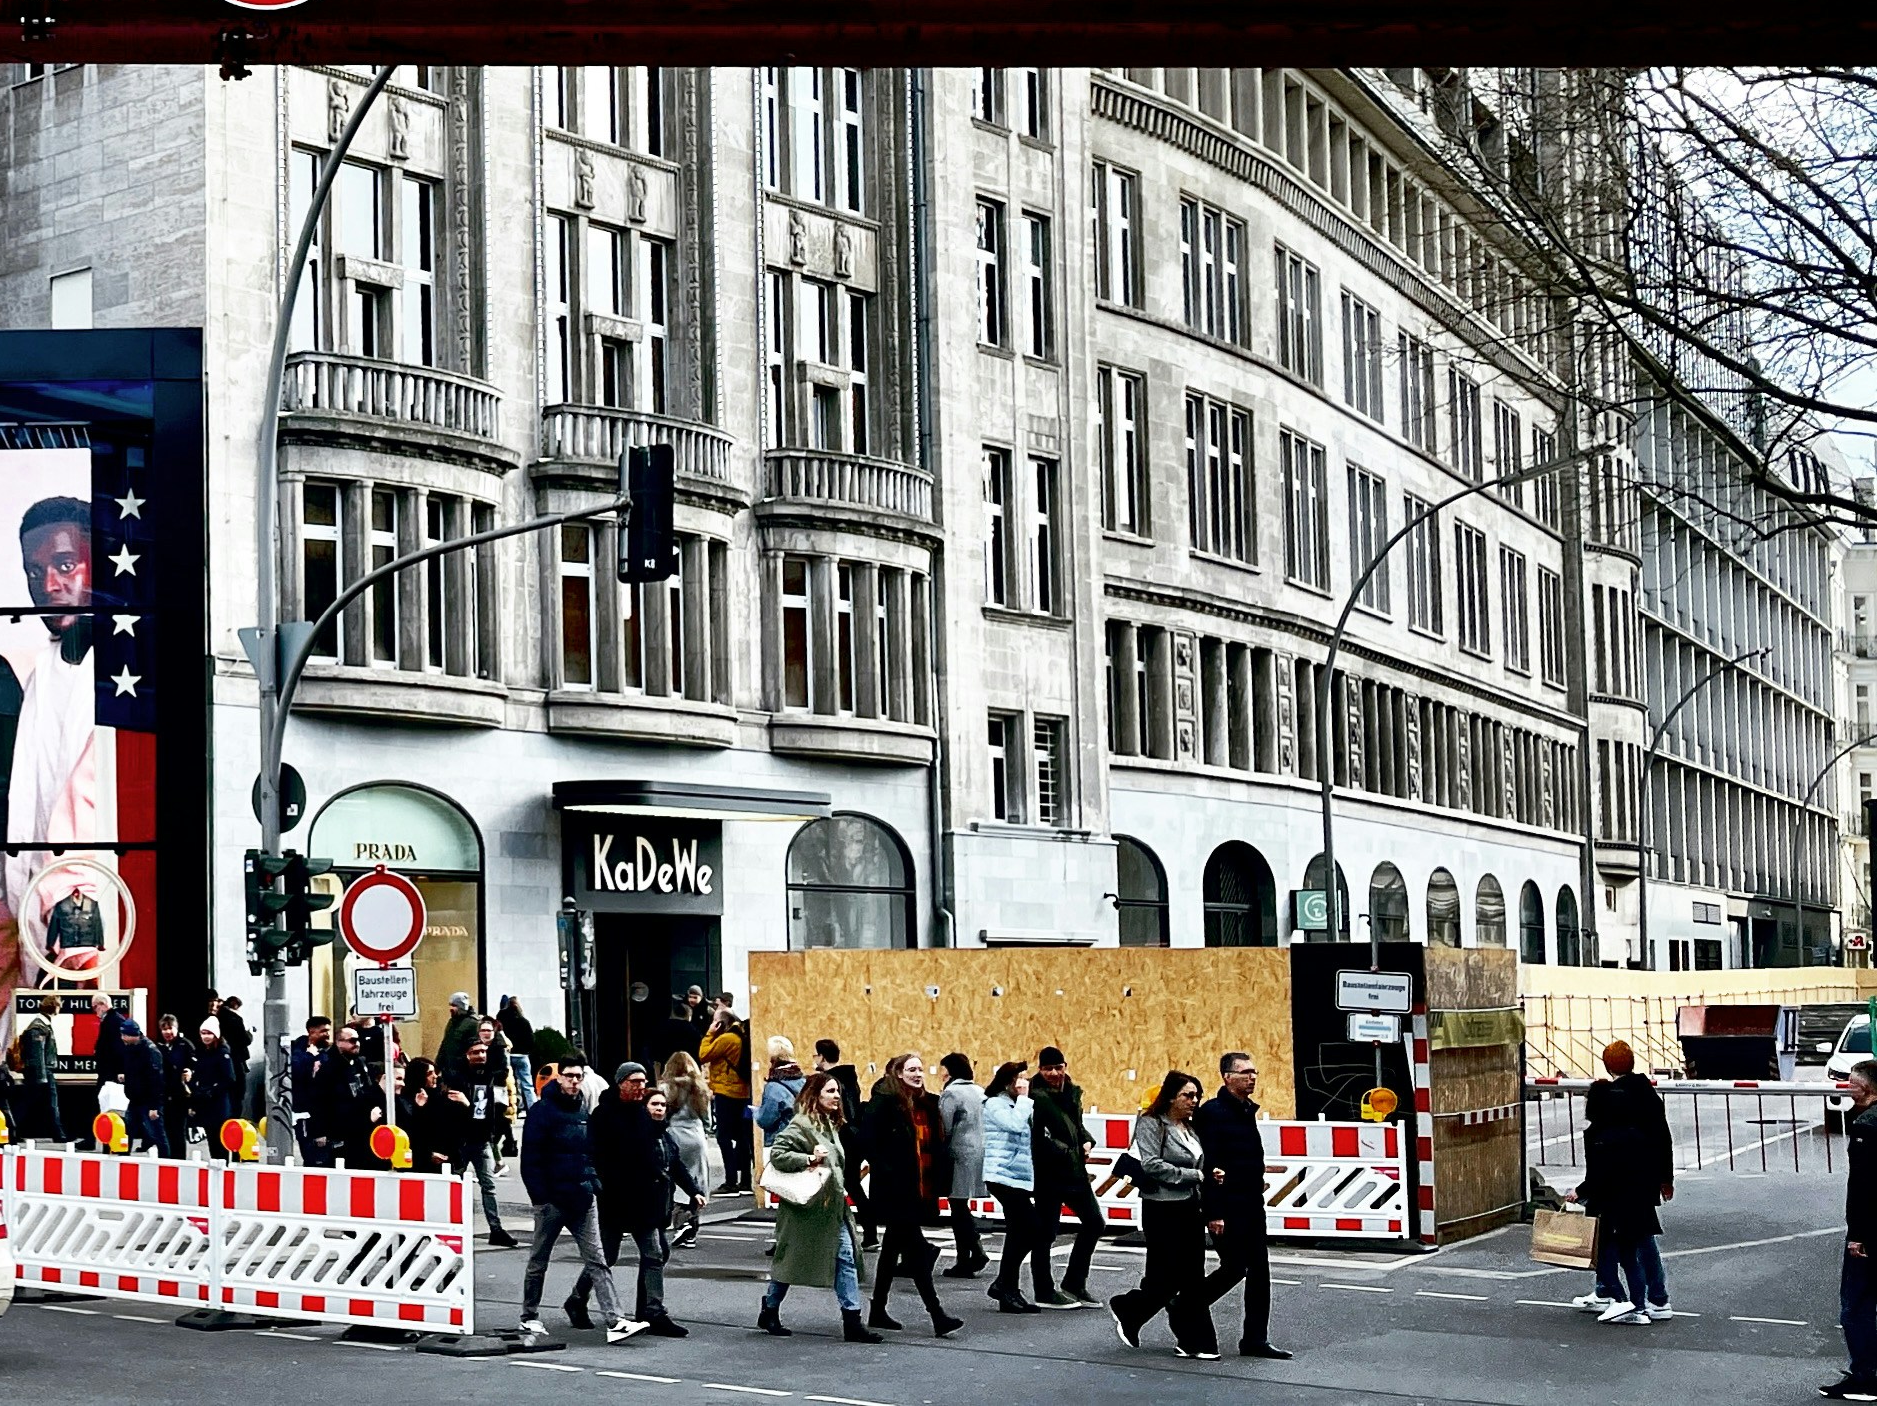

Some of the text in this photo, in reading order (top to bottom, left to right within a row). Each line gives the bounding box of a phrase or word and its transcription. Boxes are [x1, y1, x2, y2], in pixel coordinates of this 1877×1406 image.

[353, 842, 418, 862] PRADA
[593, 833, 713, 894] KaDeWe
[425, 925, 469, 937] PRADA
[358, 975, 413, 986] Baustellen-
[360, 989, 408, 1001] fahrzeuge
[378, 1002, 395, 1012] frei
